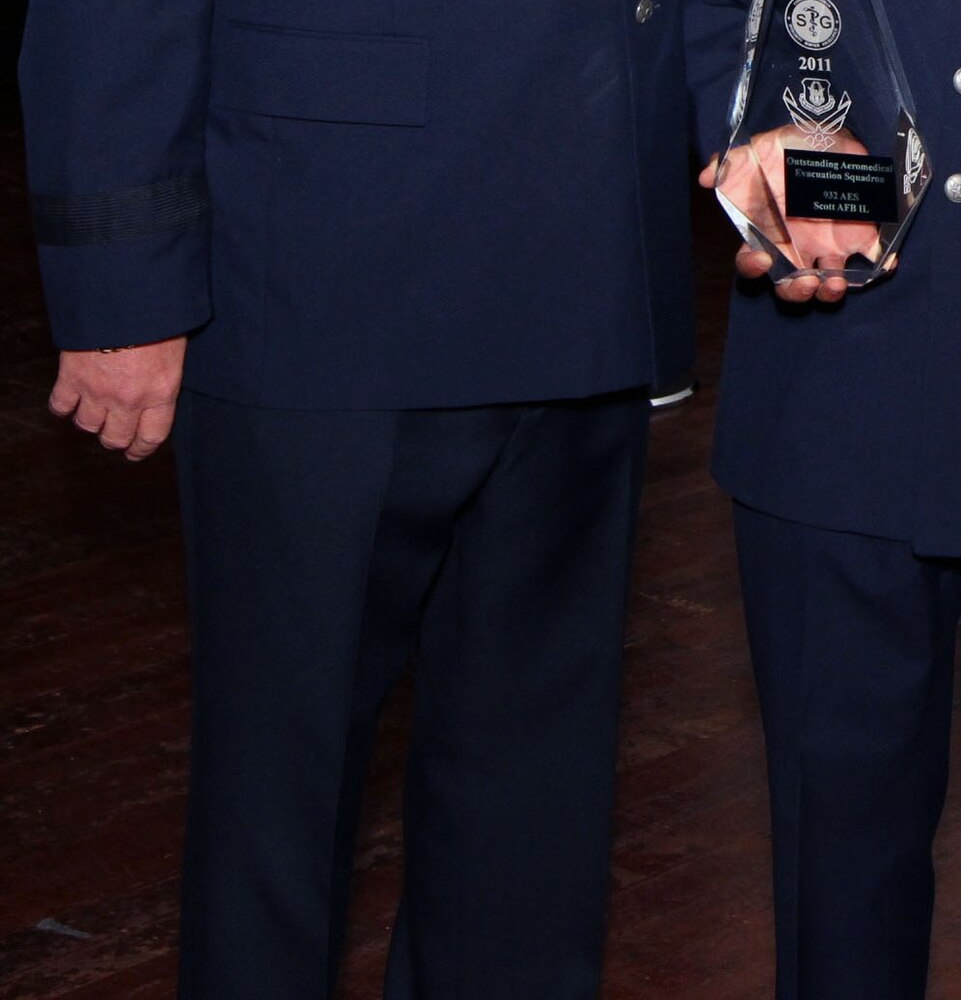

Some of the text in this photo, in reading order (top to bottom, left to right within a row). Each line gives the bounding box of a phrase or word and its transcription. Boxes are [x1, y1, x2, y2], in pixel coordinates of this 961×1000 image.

[798, 56, 831, 72] 2011
[787, 156, 893, 173] Outstanding Aeromedical
[795, 168, 885, 183] Evacuation Squadron
[823, 190, 859, 201] 932 AES
[813, 201, 835, 211] Scott
[837, 203, 857, 213] AFB
